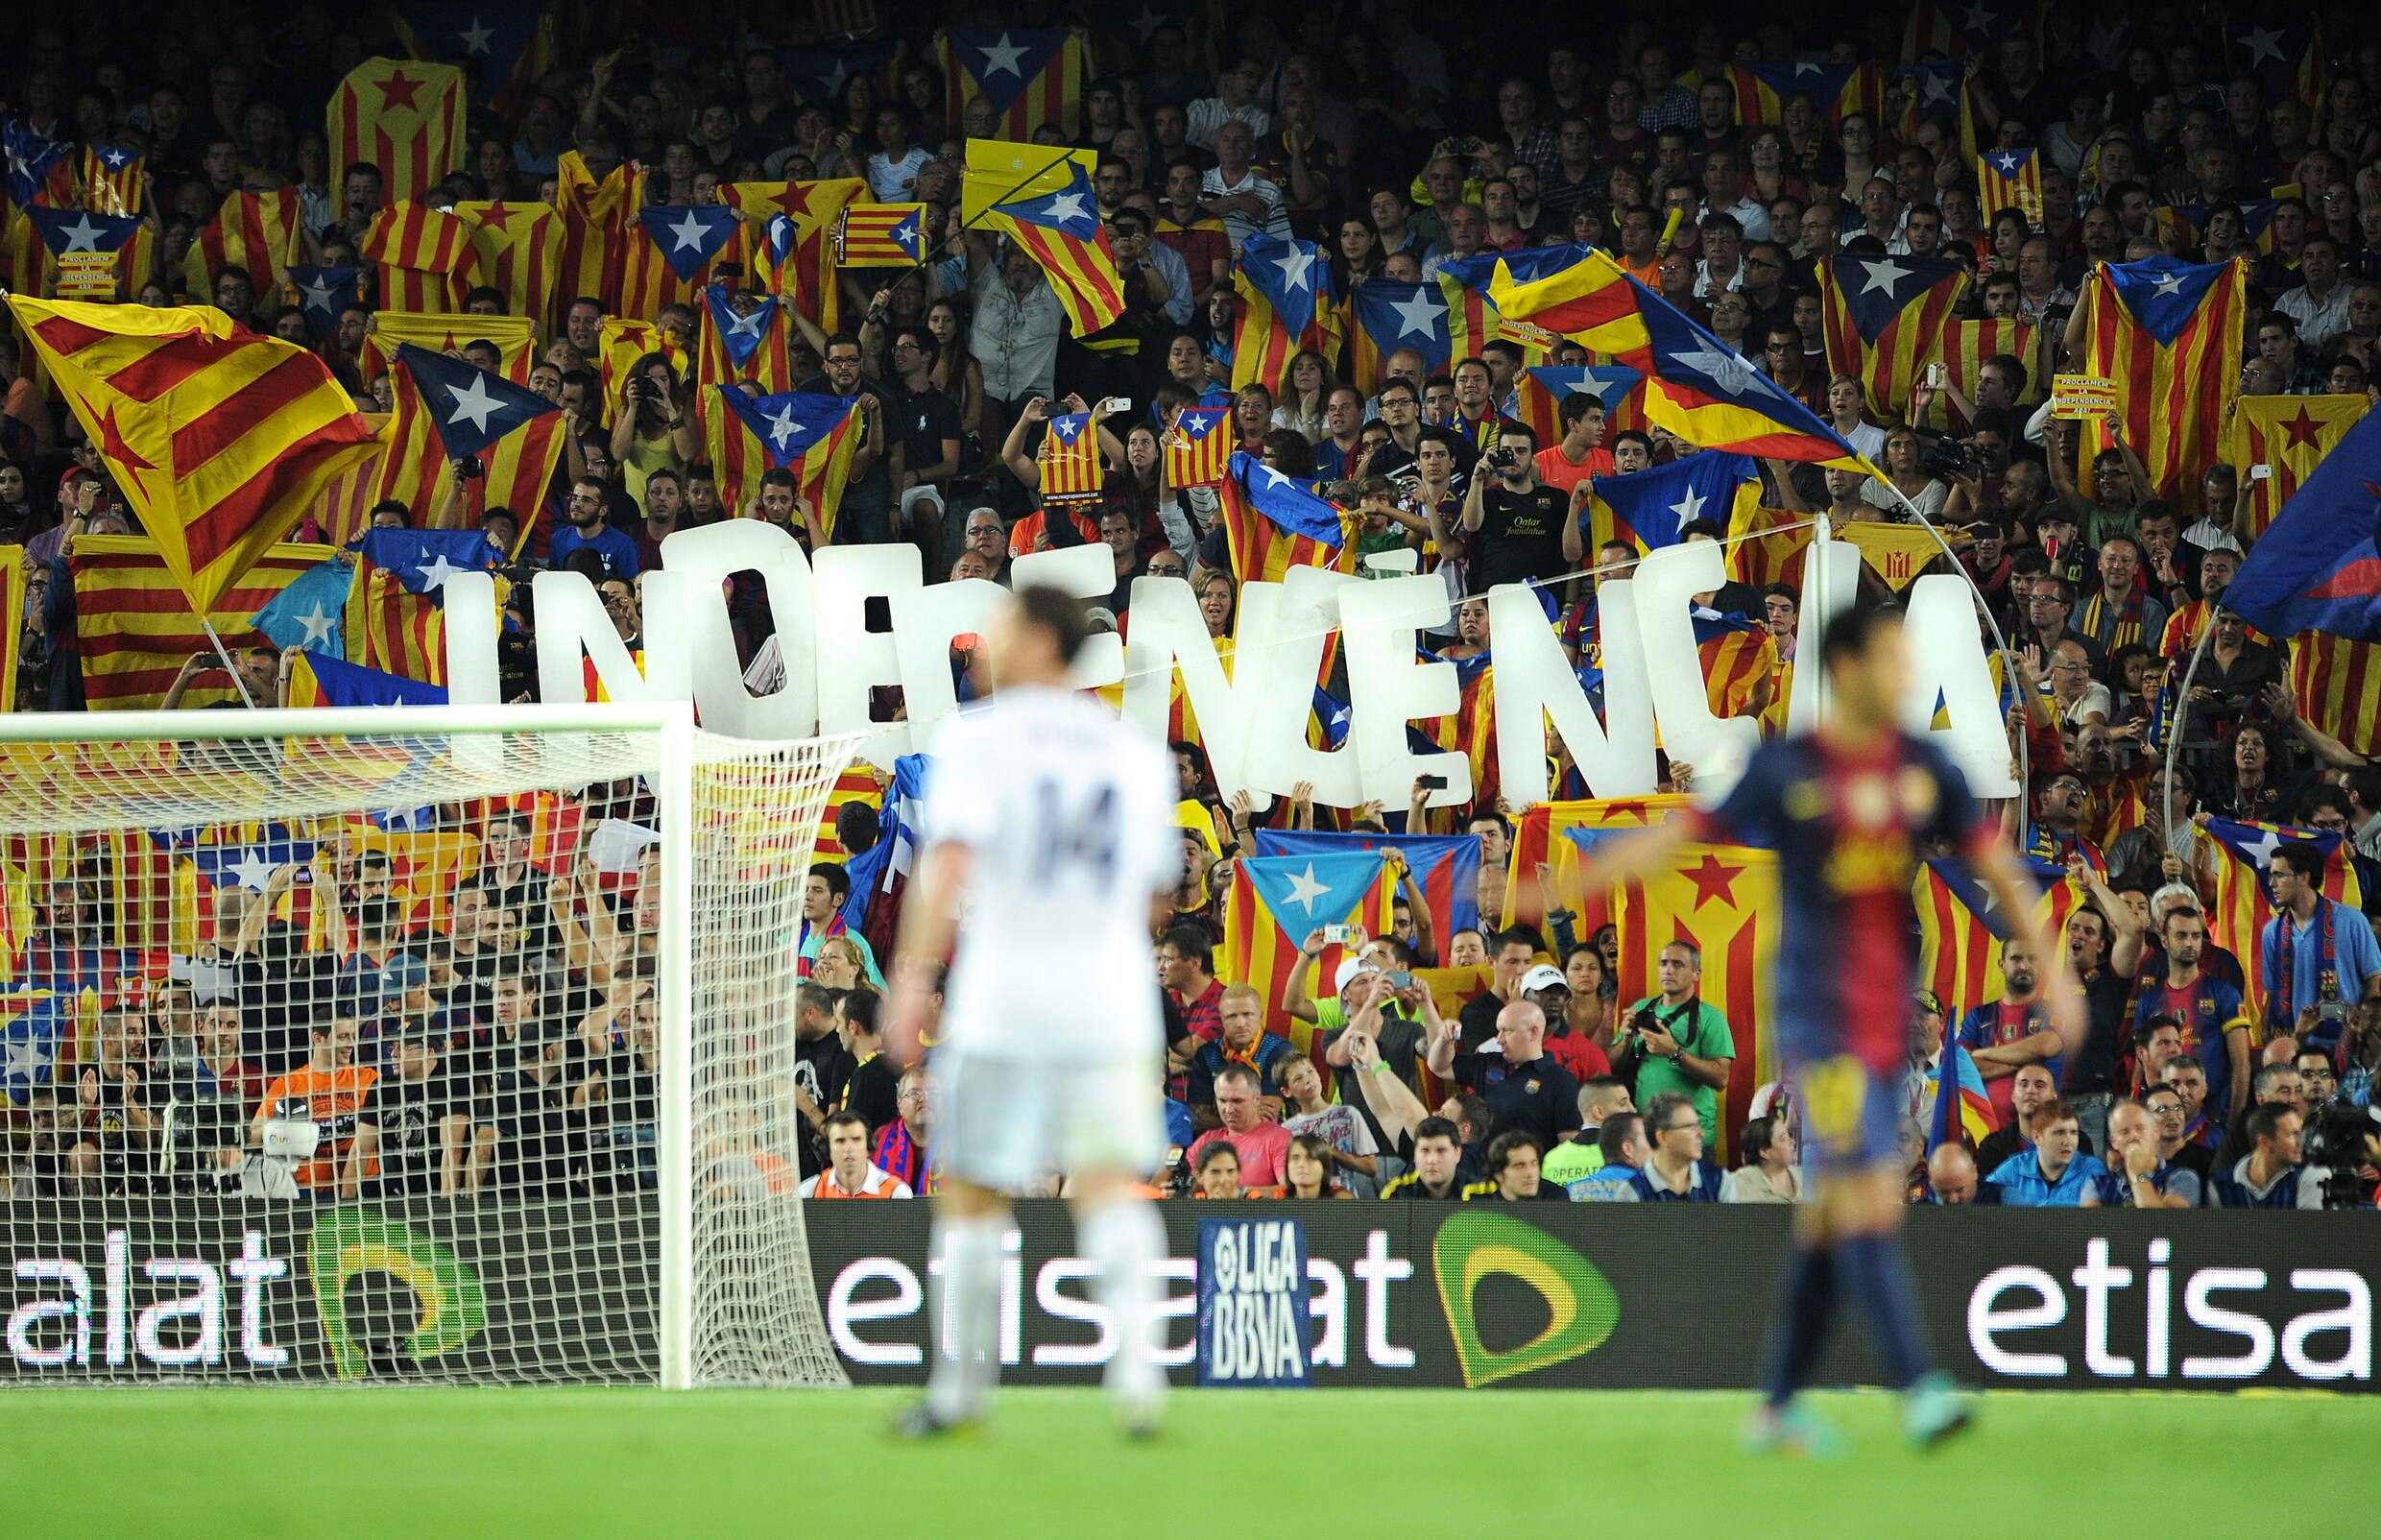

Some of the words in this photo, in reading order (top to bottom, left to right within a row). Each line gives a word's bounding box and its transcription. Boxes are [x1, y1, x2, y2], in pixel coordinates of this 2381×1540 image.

[1519, 334, 1535, 343] ARA!
[2061, 378, 2109, 388] PROCLAMEM
[1513, 516, 1542, 528] Qatar
[1029, 776, 1122, 901] 14
[1238, 1220, 1299, 1293] LIGA
[8, 1230, 289, 1366] alat
[1212, 1291, 1305, 1380] BBVA
[1968, 1238, 2372, 1381] etisa
